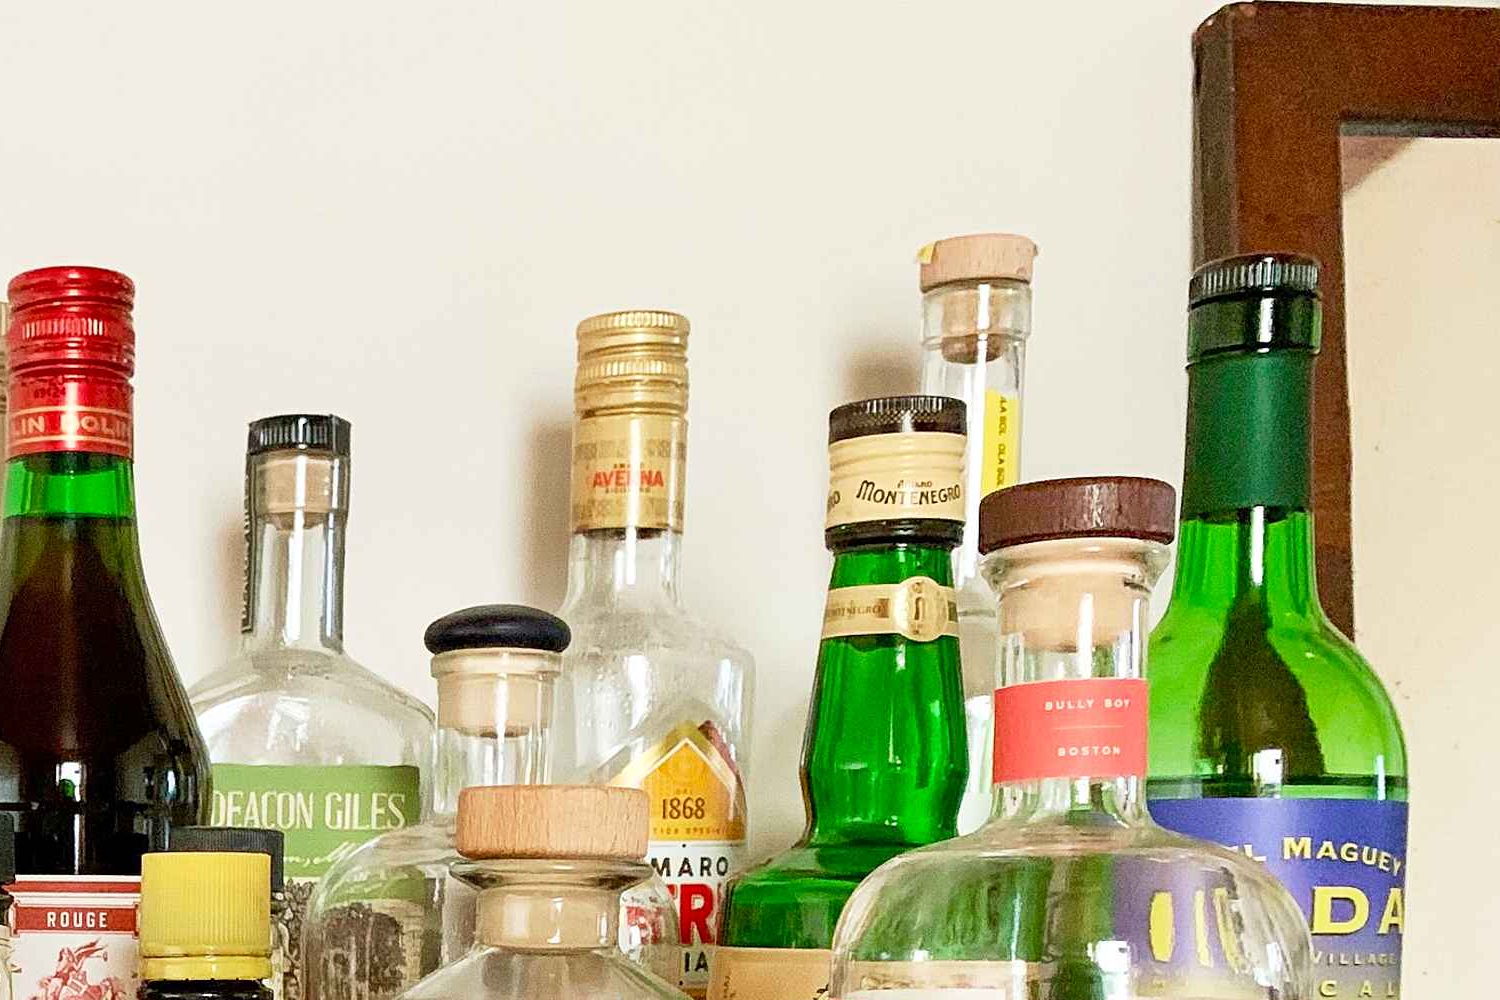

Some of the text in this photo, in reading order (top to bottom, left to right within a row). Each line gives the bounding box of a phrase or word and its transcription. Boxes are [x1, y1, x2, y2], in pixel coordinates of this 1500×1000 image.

[1044, 697, 1131, 711] BULLY BOY
[1057, 745, 1121, 757] BOSTON
[211, 789, 406, 832] DEACON GILES
[662, 797, 706, 819] 1868
[1283, 836, 1402, 876] MAGUEY
[46, 911, 108, 928] ROUGE
